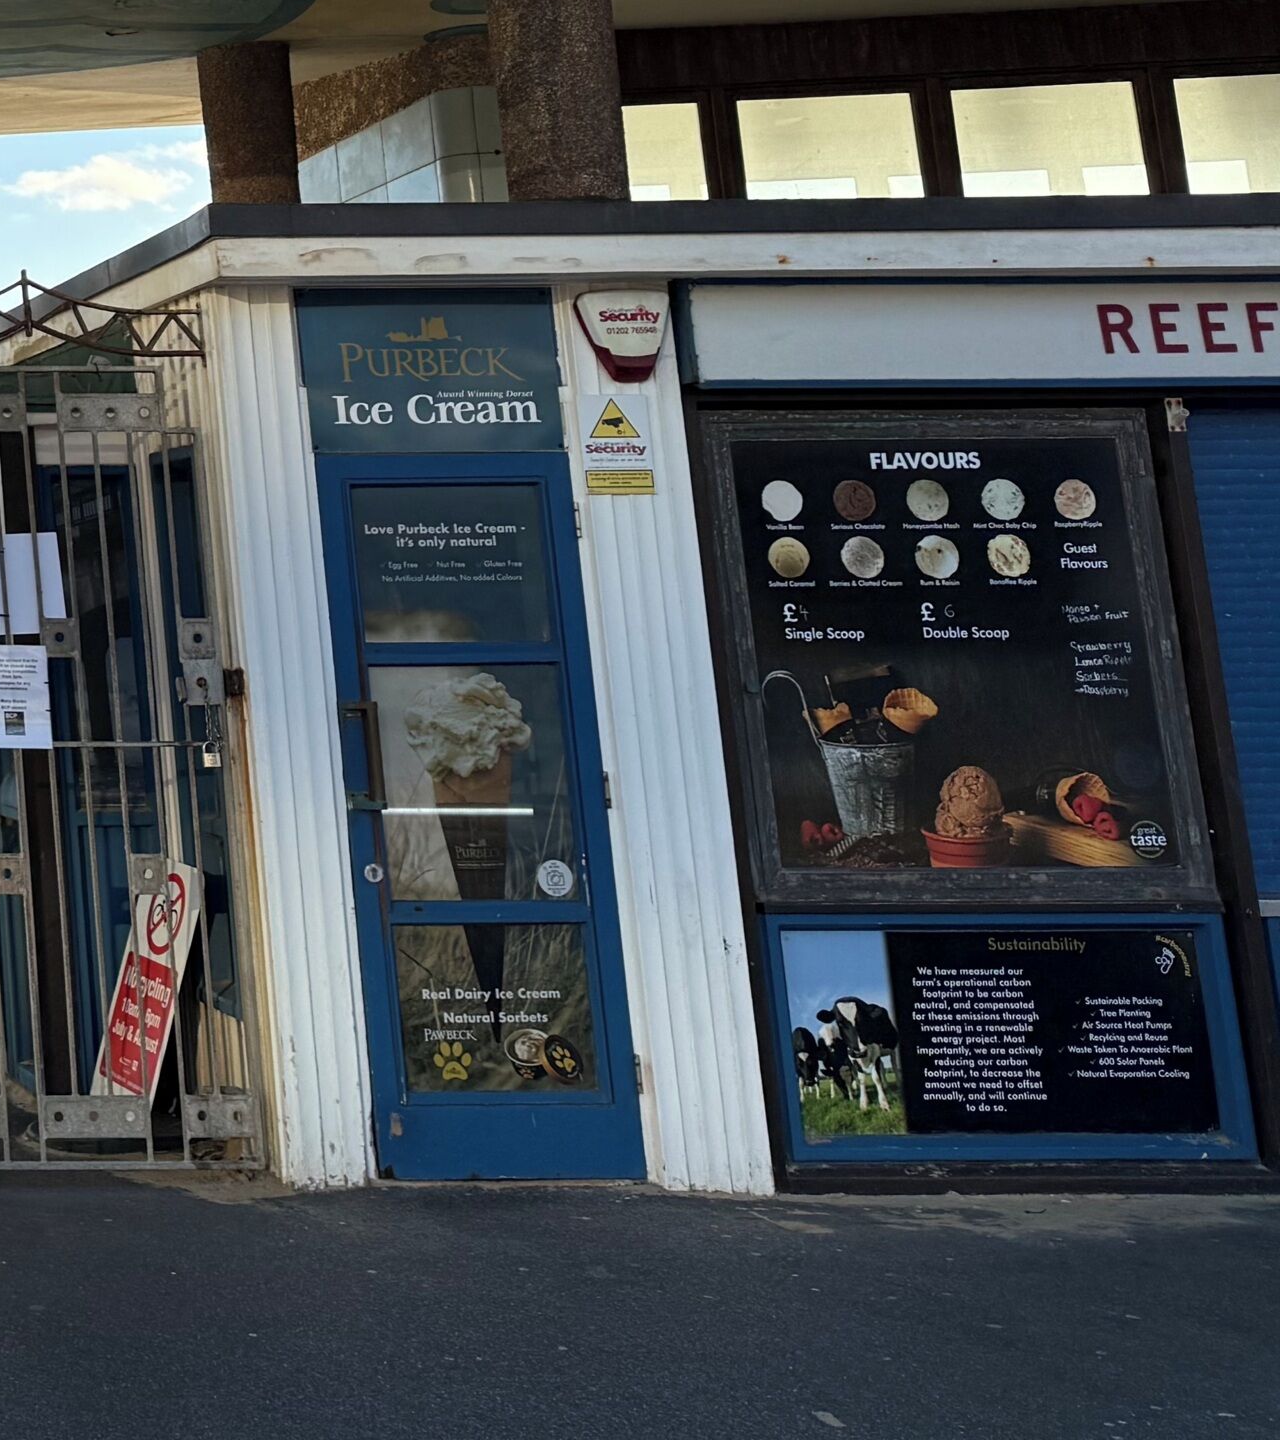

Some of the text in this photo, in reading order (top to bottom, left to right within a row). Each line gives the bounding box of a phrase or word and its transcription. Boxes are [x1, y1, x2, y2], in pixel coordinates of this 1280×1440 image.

[599, 309, 660, 324] Security
[607, 327, 629, 335] 01202
[1096, 302, 1279, 354] REEF
[338, 342, 526, 383] PURBECK
[436, 389, 534, 400] Award Winning Dorset
[331, 394, 542, 425] Ice Cream
[586, 443, 647, 456] Security
[869, 451, 981, 470] FLAVOURS
[364, 522, 517, 535] Love Purbeck Ice Cream
[418, 535, 446, 550] only
[450, 535, 497, 547] natural
[1063, 542, 1097, 554] Guest
[1060, 557, 1108, 569] Flavours
[785, 627, 865, 642] Single Scoop
[922, 626, 1010, 640] Double Scoop
[1130, 834, 1168, 847] taste
[987, 936, 1087, 954] Sustainability
[916, 966, 1024, 975] We have measured our
[912, 976, 1031, 989] farm's operational carbon
[422, 988, 561, 1002] Real Dairy Ice Cream
[953, 1000, 971, 1009] and
[973, 1000, 1035, 1012] compensated
[1085, 997, 1163, 1007] Sustainable Packing
[443, 1011, 549, 1024] Natural Sorbets
[912, 1011, 1040, 1023] for those emissions through
[1099, 1010, 1117, 1018] Tree
[1096, 1021, 1123, 1030] Source
[1124, 1021, 1144, 1030] Heat
[1145, 1021, 1173, 1030] Pumps
[424, 1028, 478, 1041] PAWBECK
[931, 1035, 1026, 1045] energy project. Most
[134, 1029, 159, 1054] Aust
[916, 1045, 1044, 1057] importantly, we are actively
[934, 1057, 1028, 1067] reducing our carbon
[1098, 1058, 1165, 1066] 600 Solar Panels
[924, 1068, 1041, 1079] footprint, to decrease the
[1076, 1070, 1190, 1079] Natural Evaporation Cooling
[923, 1091, 1048, 1102] annually, and will continue
